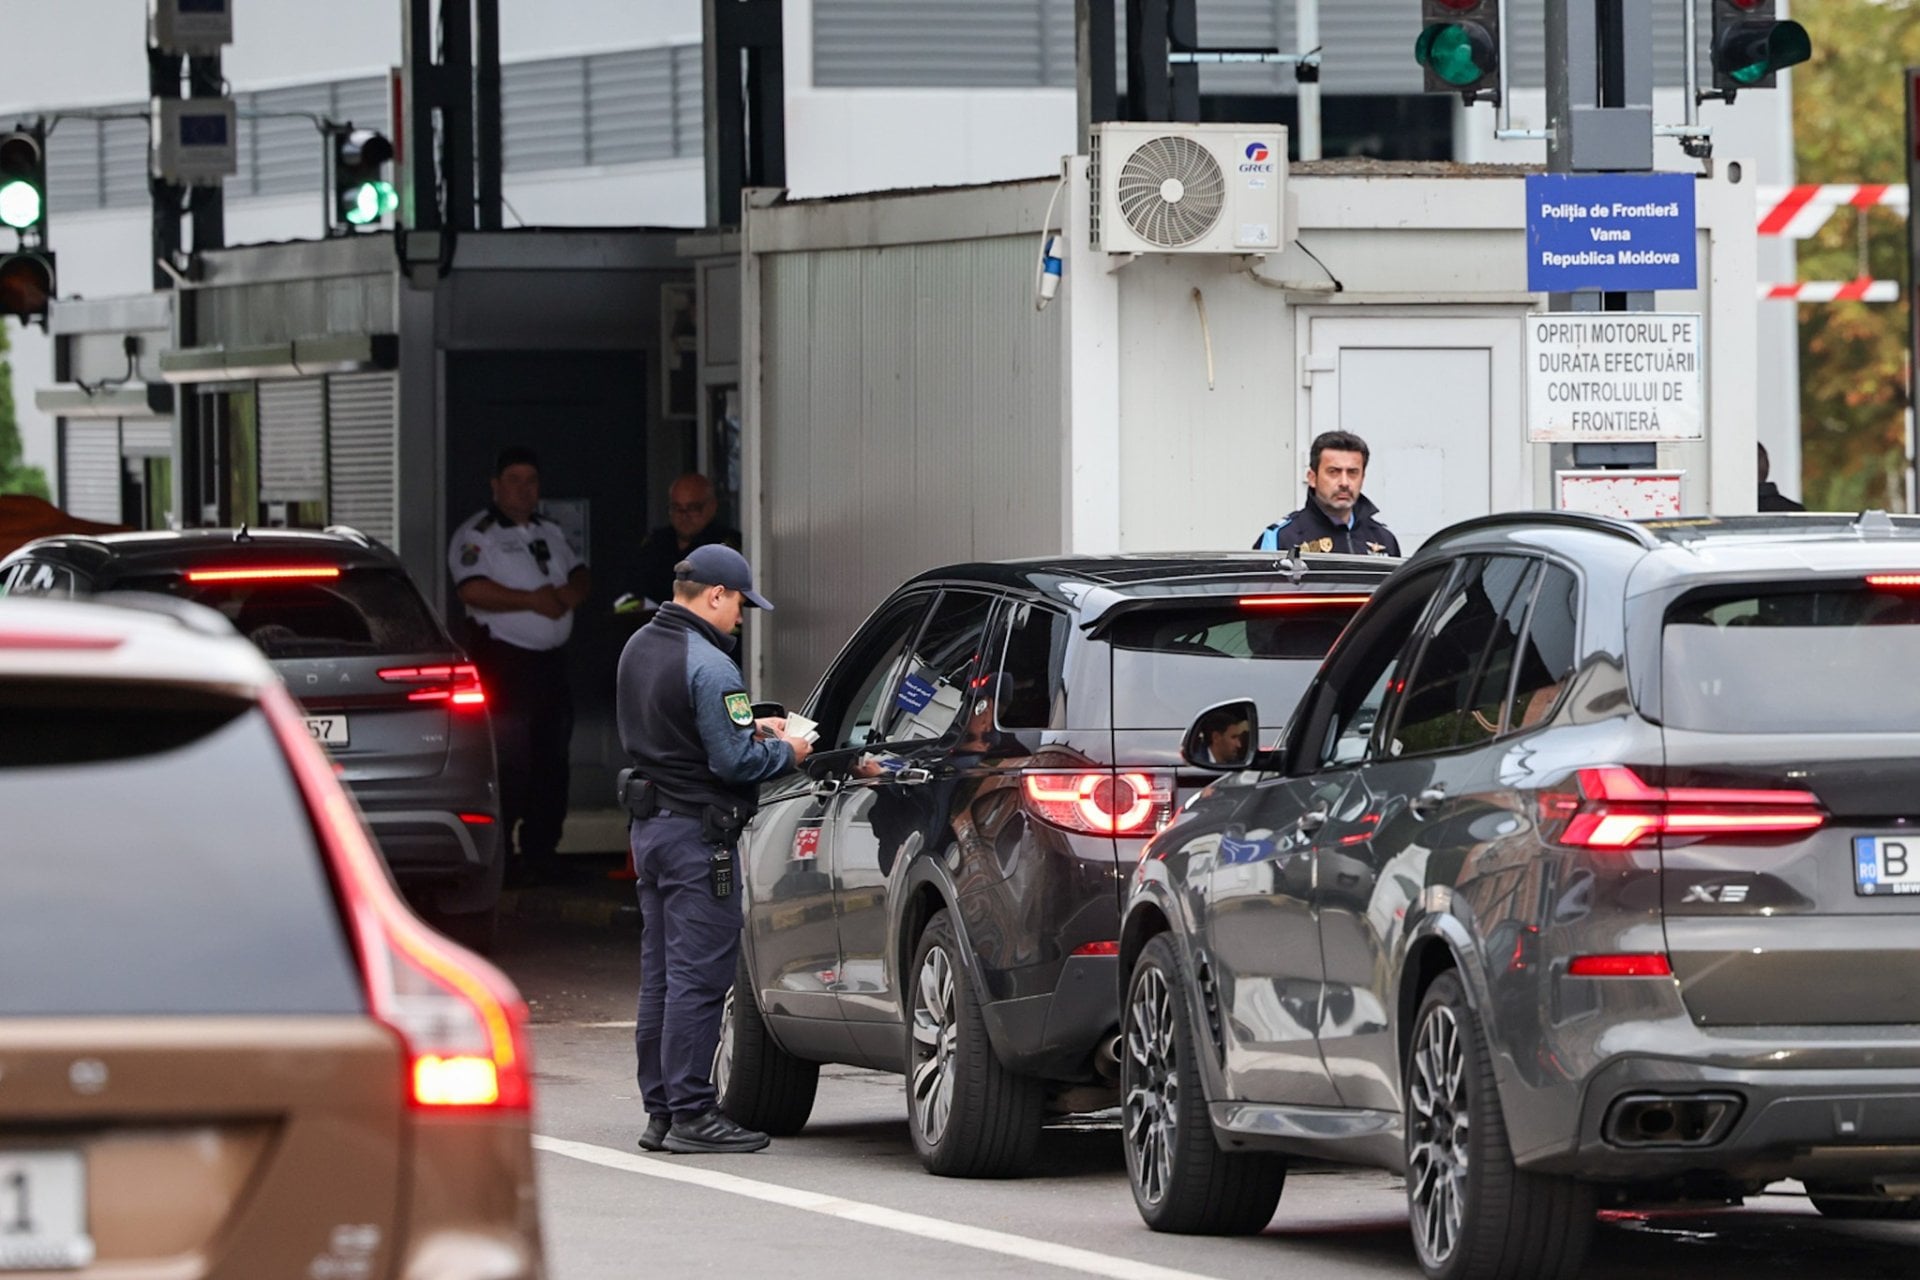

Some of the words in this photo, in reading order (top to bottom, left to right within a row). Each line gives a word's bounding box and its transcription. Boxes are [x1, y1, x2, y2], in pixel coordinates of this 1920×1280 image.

[1239, 163, 1273, 173] GREE
[1590, 204, 1609, 218] de
[1612, 203, 1679, 218] Frontieră
[1590, 227, 1631, 241] Vama
[1542, 251, 1615, 268] Republica
[1618, 250, 1680, 265] Moldova
[1591, 323, 1668, 344] MOTORUL
[1672, 323, 1692, 343] PE
[1539, 353, 1600, 373] DURATA
[1604, 348, 1695, 373] EFECTUĂRII
[1549, 382, 1658, 402] CONTROLULUI
[1662, 382, 1683, 401] DE
[1572, 407, 1660, 432] FRONTIERĂ
[1882, 842, 1908, 877] B
[1681, 885, 1749, 902] X5
